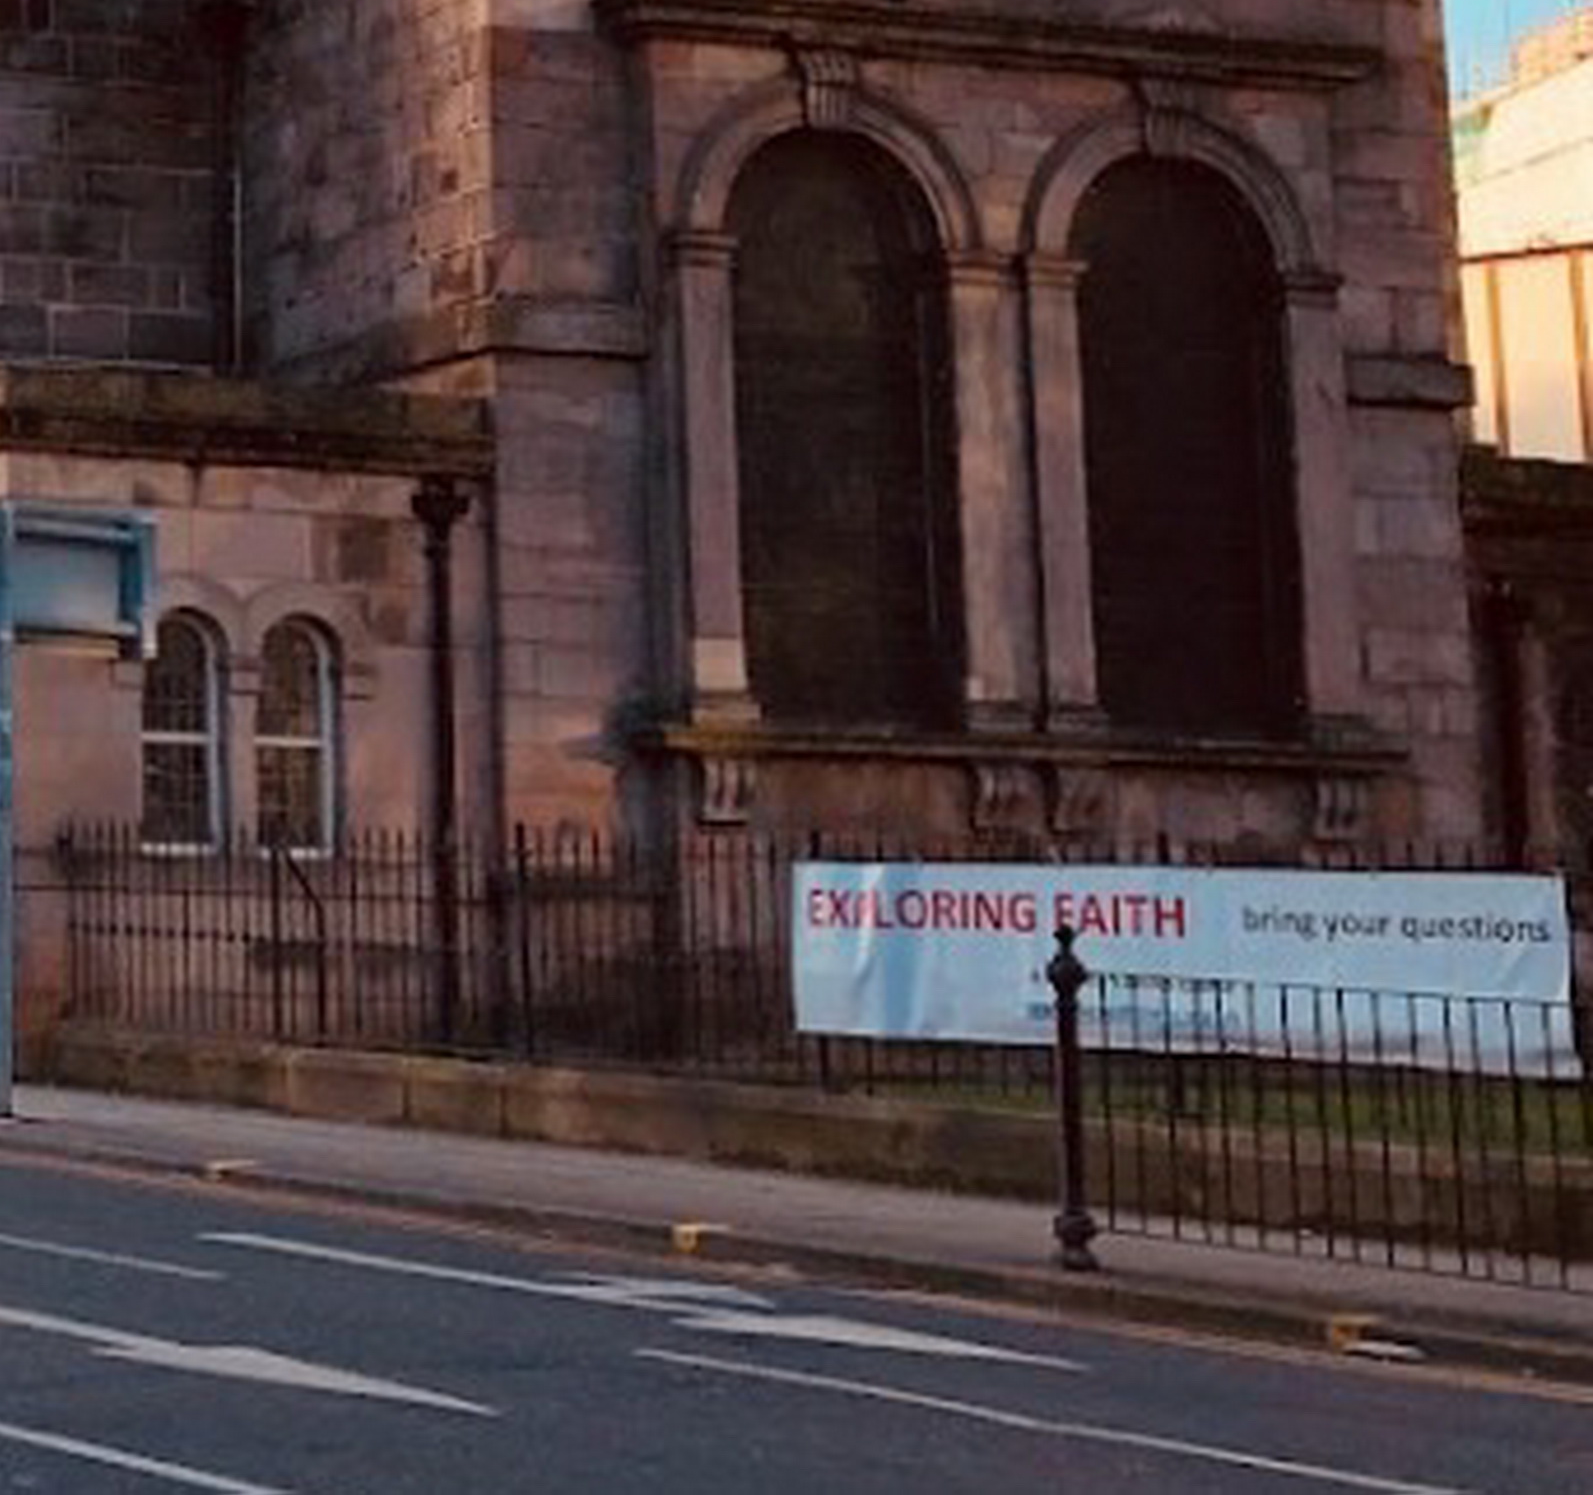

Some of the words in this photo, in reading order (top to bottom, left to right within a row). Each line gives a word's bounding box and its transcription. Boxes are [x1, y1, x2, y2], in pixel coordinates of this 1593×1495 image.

[1053, 893, 1186, 938] FAITH
[1242, 908, 1317, 942] bring
[1322, 913, 1391, 942] your
[1400, 913, 1552, 944] questions
